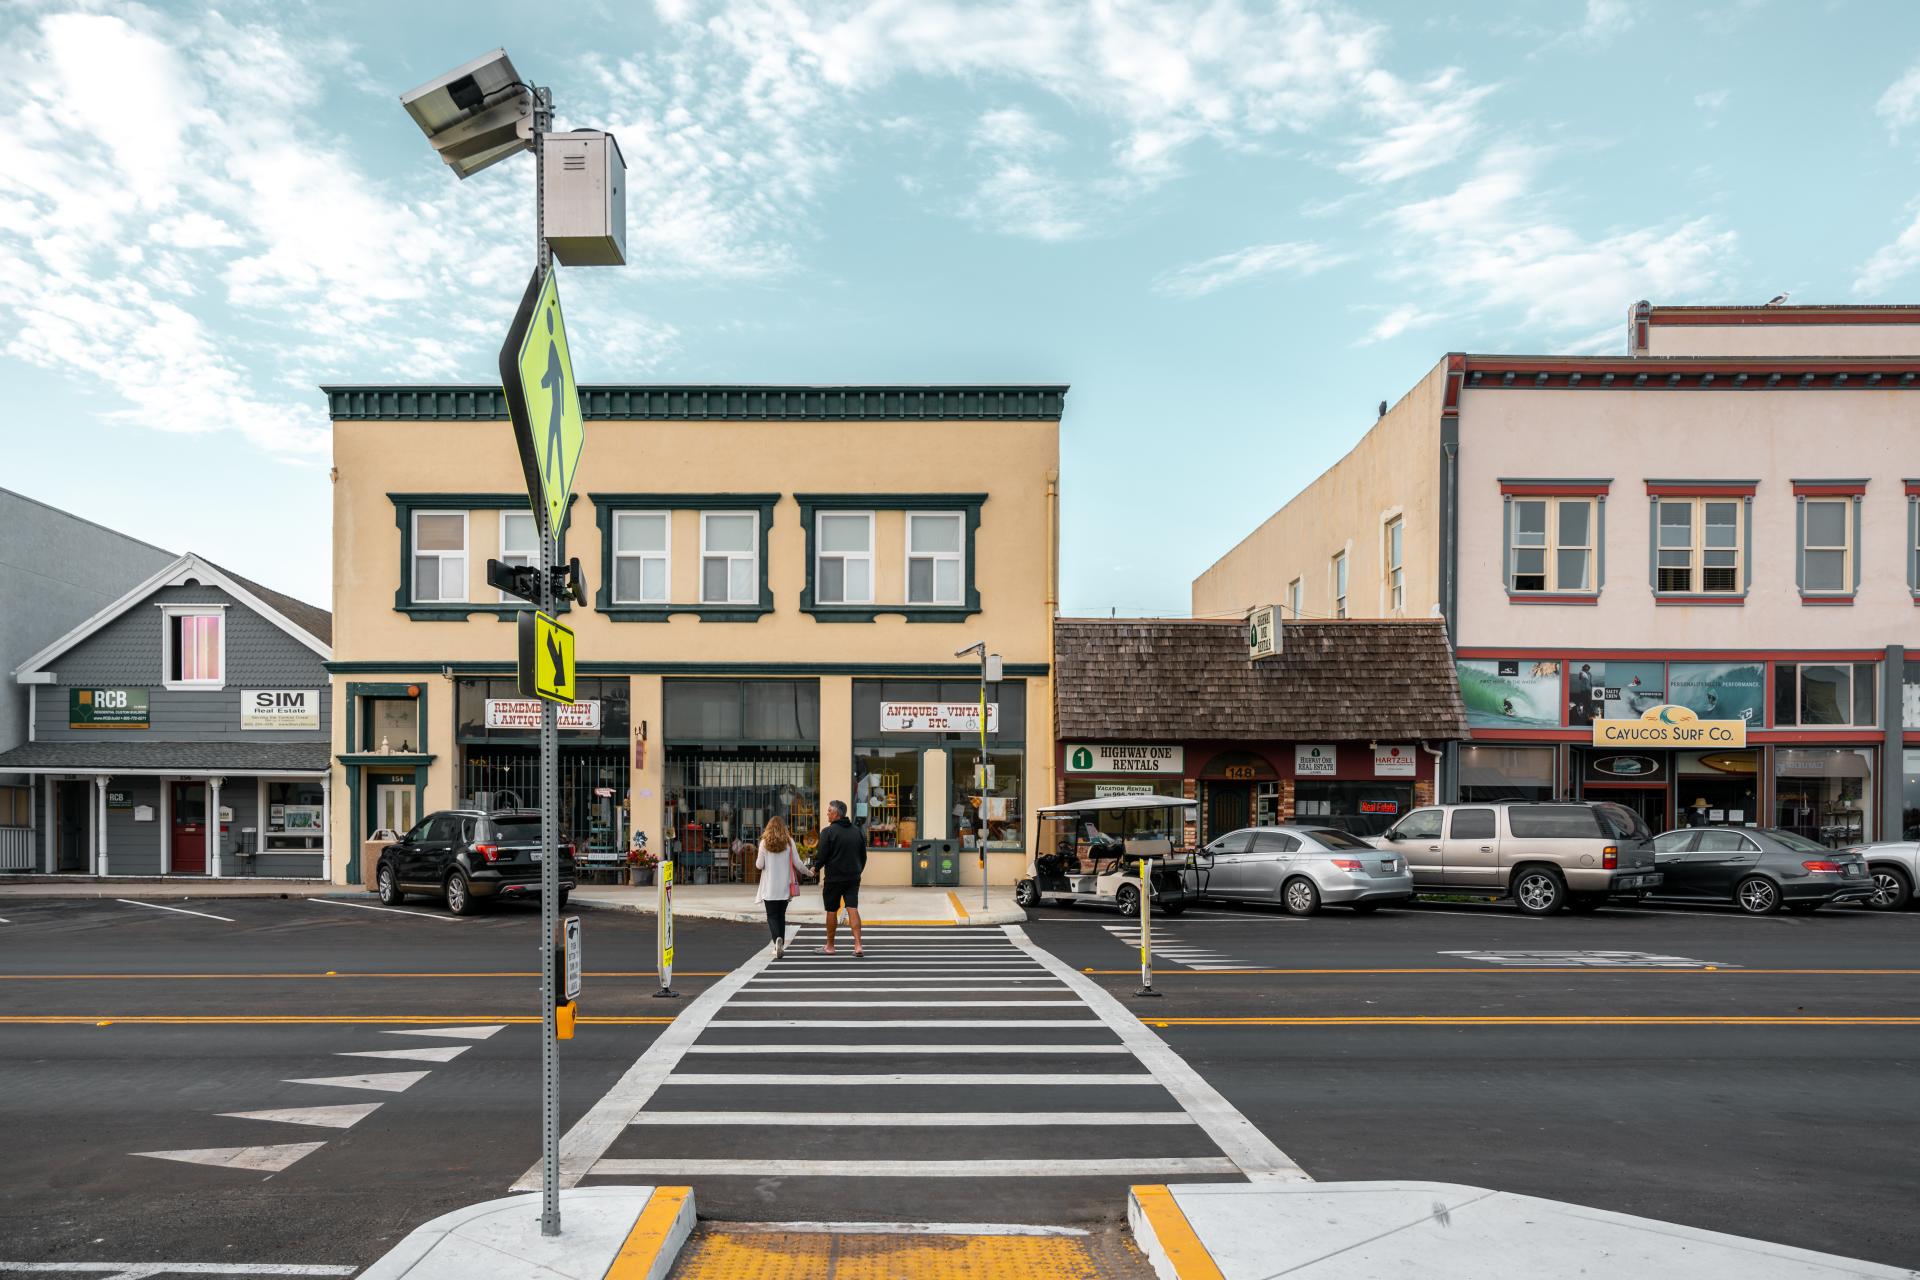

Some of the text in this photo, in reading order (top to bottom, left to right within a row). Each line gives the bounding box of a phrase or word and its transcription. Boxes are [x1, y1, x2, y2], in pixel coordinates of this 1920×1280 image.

[95, 691, 127, 707] RCB
[256, 693, 304, 706] SIM
[494, 703, 591, 714] REMEMB WHEN
[887, 706, 993, 717] ANTIQUES VINTAE
[501, 715, 542, 727] ANTIQU
[928, 719, 950, 728] ETC.
[1605, 726, 1667, 740] CAYUCOS
[1673, 727, 1704, 740] SURF
[1101, 747, 1171, 758] HIGHWAY ONE
[1078, 752, 1084, 766] 1
[1113, 760, 1159, 770] RENTALS
[1230, 768, 1252, 778] 148
[1361, 801, 1396, 813] Real Estate
